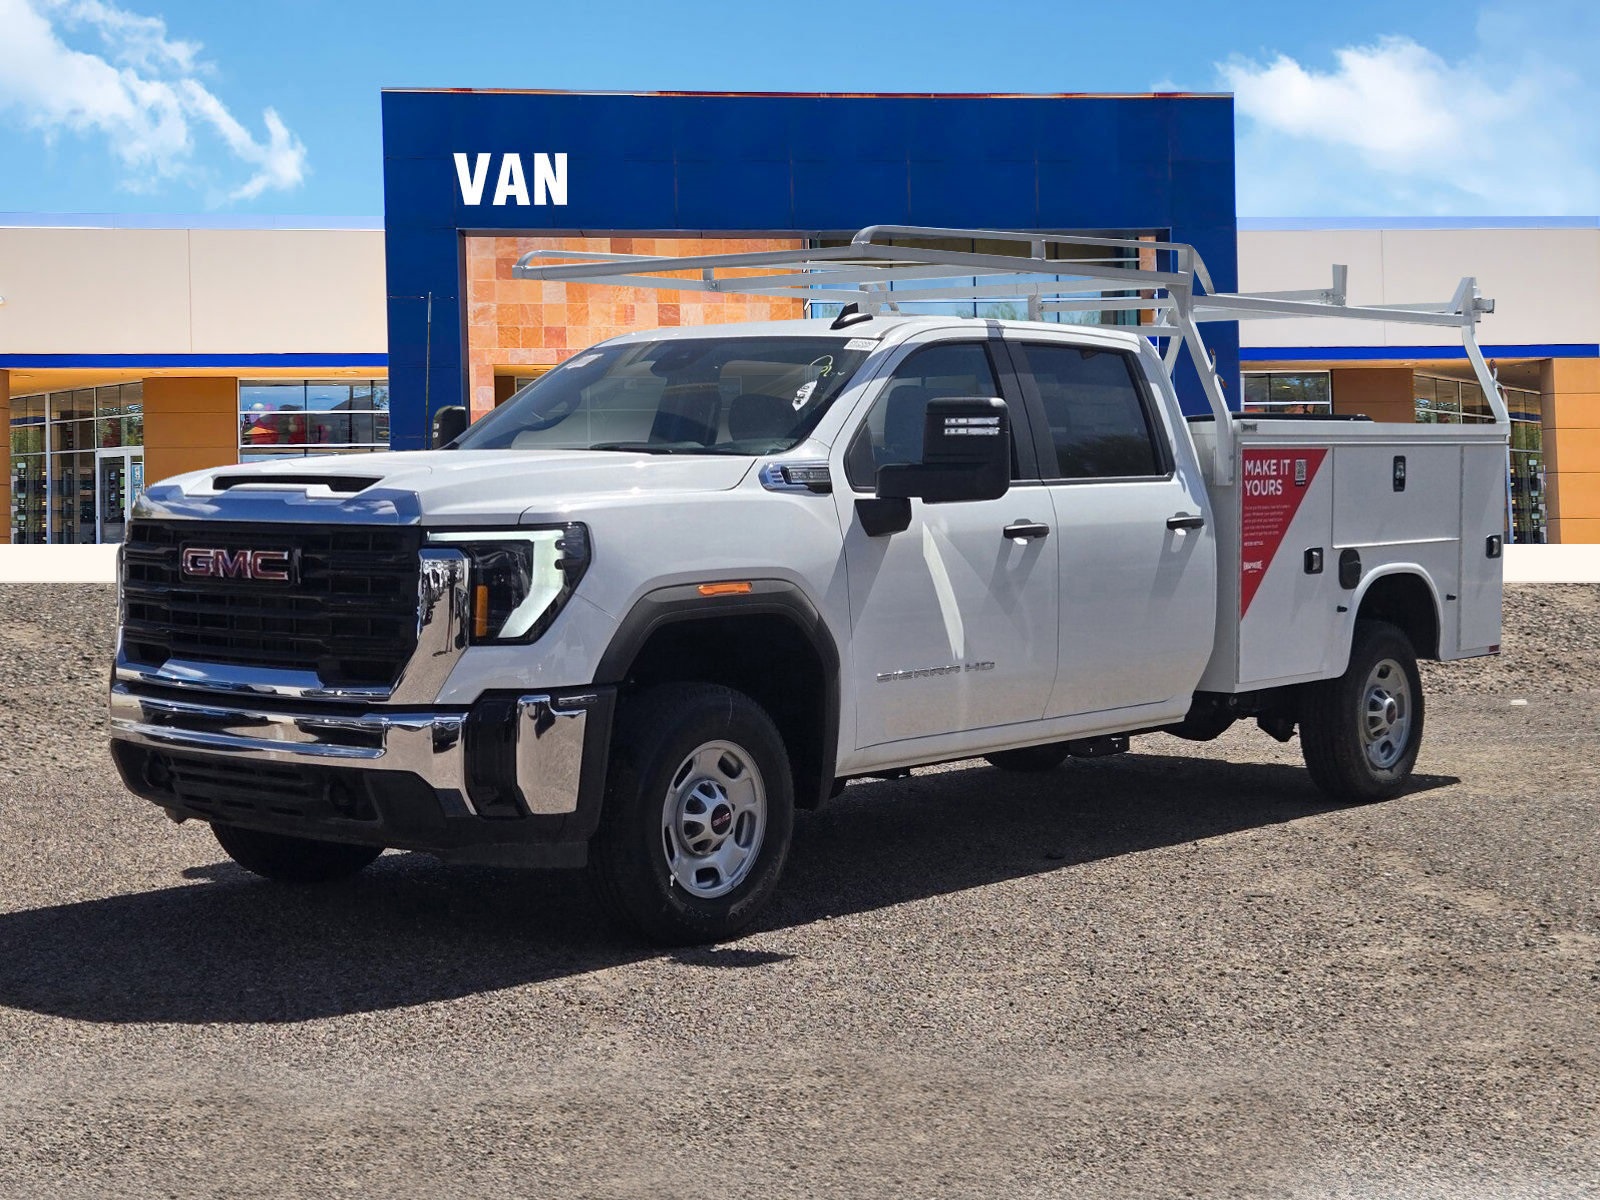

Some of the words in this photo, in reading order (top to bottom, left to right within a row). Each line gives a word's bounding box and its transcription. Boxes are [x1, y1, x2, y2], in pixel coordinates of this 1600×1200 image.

[453, 152, 568, 206] VAN
[1245, 459, 1277, 476] MAKE
[1280, 459, 1291, 475] IT
[1244, 479, 1283, 496] YOURS
[182, 547, 289, 580] GMC
[876, 664, 960, 682] SIERRA
[965, 661, 995, 672] HD
